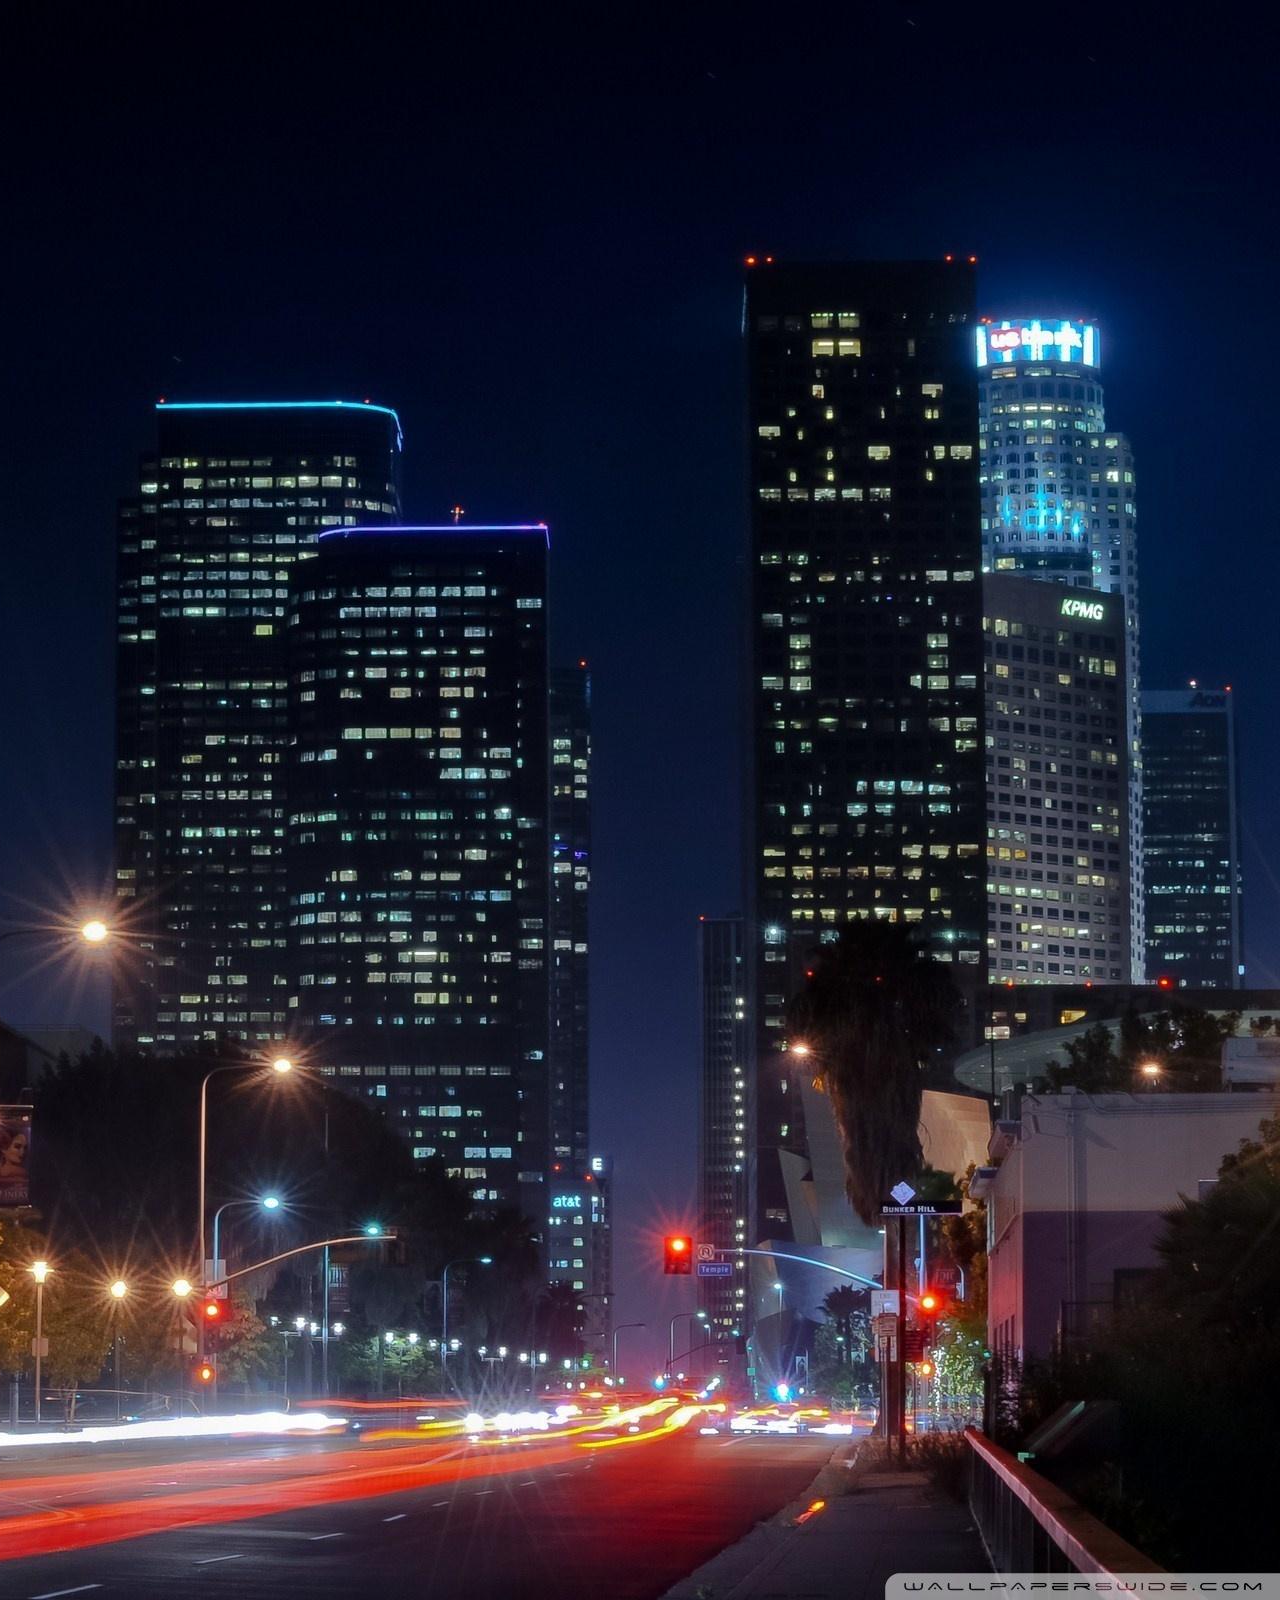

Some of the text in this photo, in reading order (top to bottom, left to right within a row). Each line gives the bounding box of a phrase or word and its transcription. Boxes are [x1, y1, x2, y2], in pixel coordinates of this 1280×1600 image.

[1061, 598, 1104, 620] KPMG
[591, 1157, 603, 1171] E
[552, 1195, 582, 1208] at&t
[882, 1205, 937, 1213] BUNKER HILL
[700, 1265, 729, 1274] Temple
